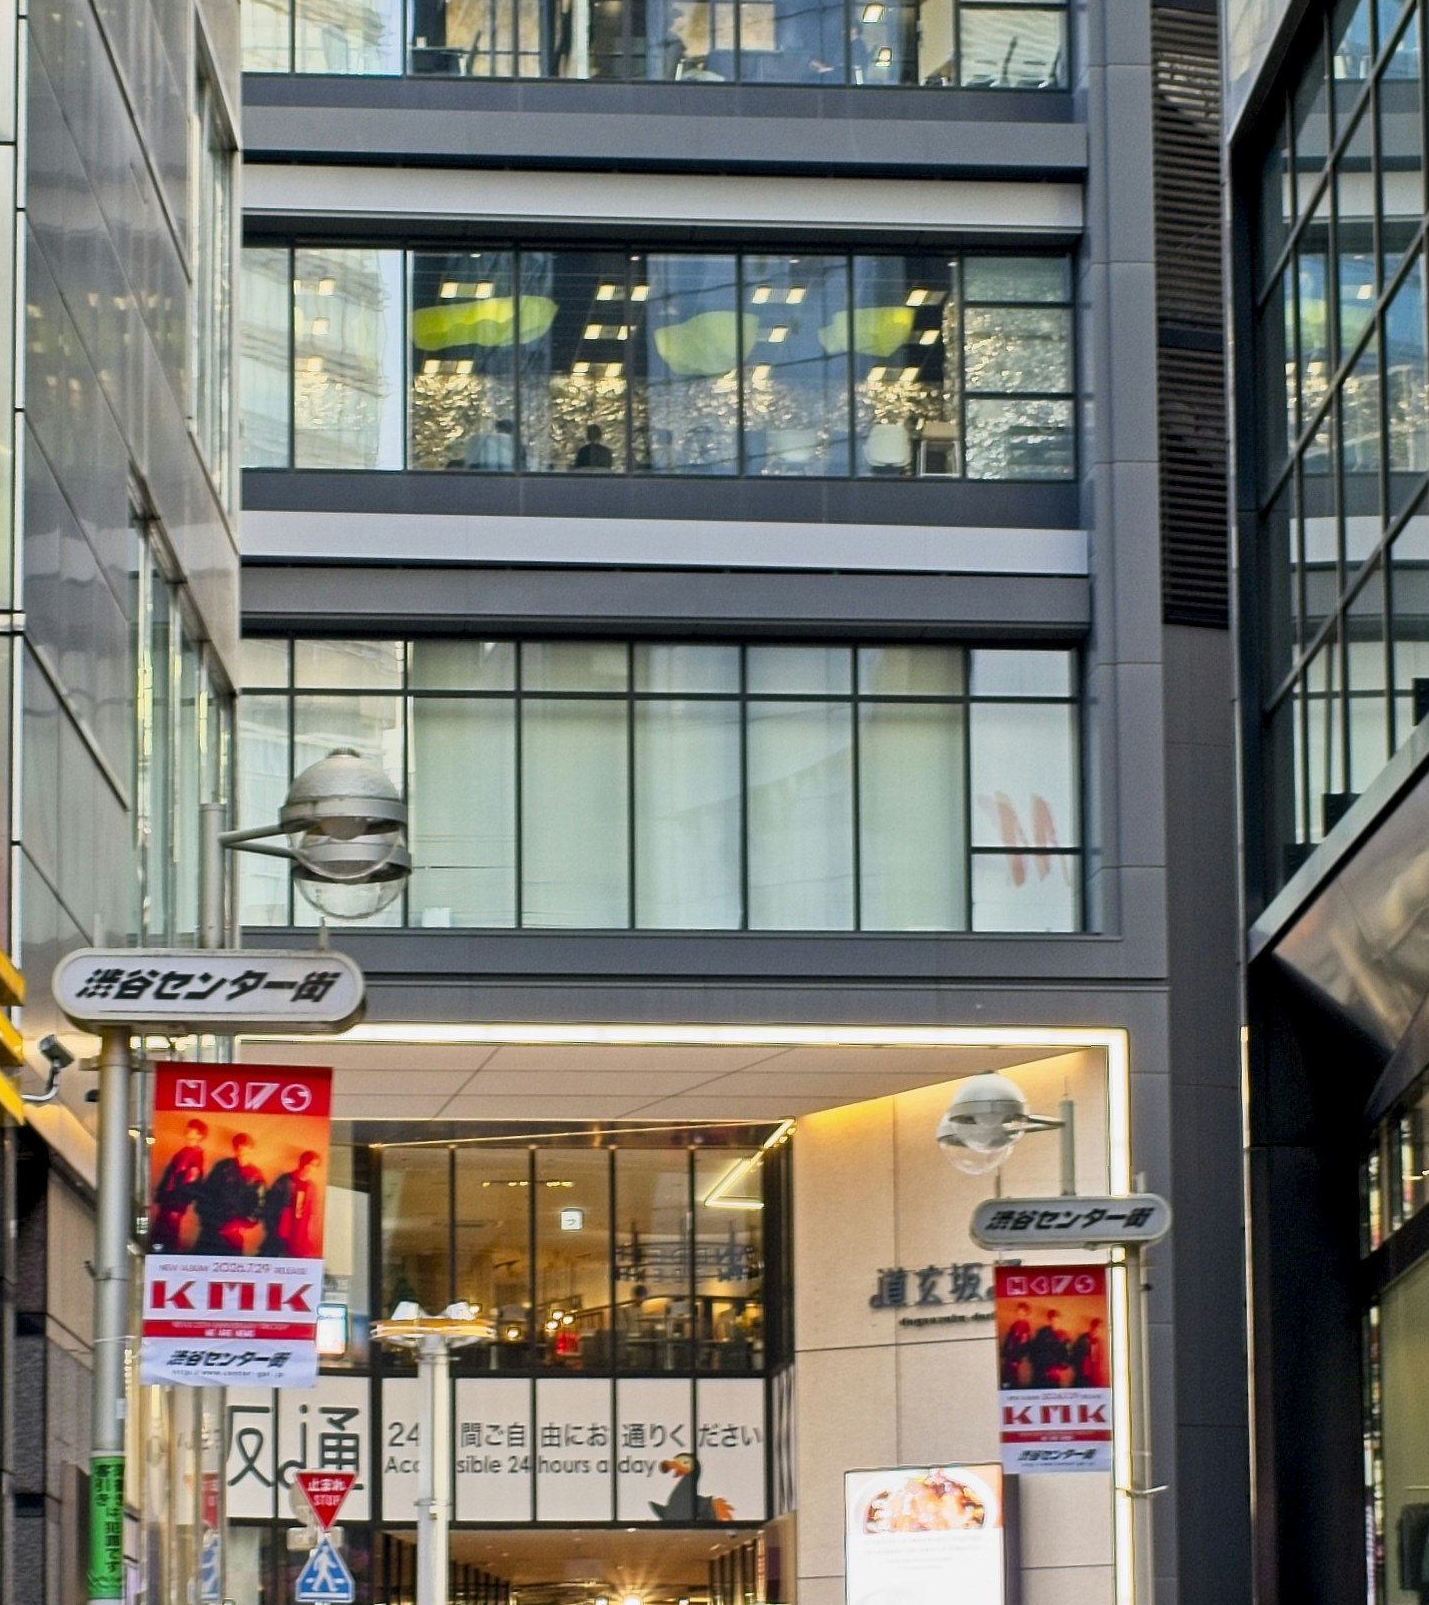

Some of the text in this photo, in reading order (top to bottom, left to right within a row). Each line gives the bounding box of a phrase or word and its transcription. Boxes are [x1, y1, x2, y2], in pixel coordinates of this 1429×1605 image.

[75, 966, 342, 1005] 渋谷センター街
[984, 1206, 1155, 1231] 渋谷センター街
[869, 1258, 1021, 1309] 道玄坂
[166, 1349, 292, 1368] 渋谷センター街
[387, 1422, 763, 1449] 24間ご自由にお通りください
[384, 1455, 655, 1479] Accsible 24 hours a day
[307, 1478, 347, 1493] 止まれ
[312, 1494, 342, 1506] STOP
